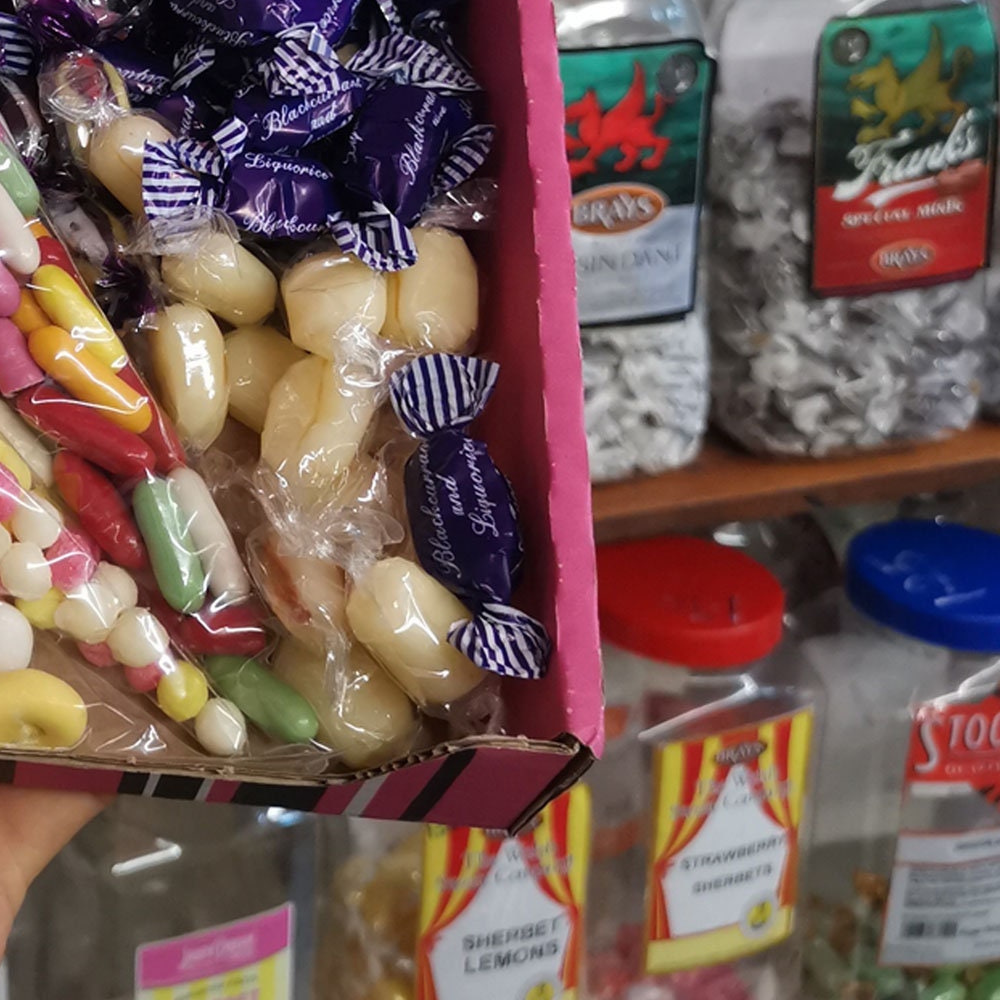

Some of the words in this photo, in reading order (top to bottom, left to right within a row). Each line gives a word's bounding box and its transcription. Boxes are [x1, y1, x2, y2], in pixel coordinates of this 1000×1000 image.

[244, 152, 330, 181] Liquorice
[572, 191, 655, 230] BRAYS
[417, 442, 462, 579] Blackcurran
[437, 474, 465, 516] and
[461, 915, 563, 952] SHERBET
[463, 938, 559, 975] LEMONS
